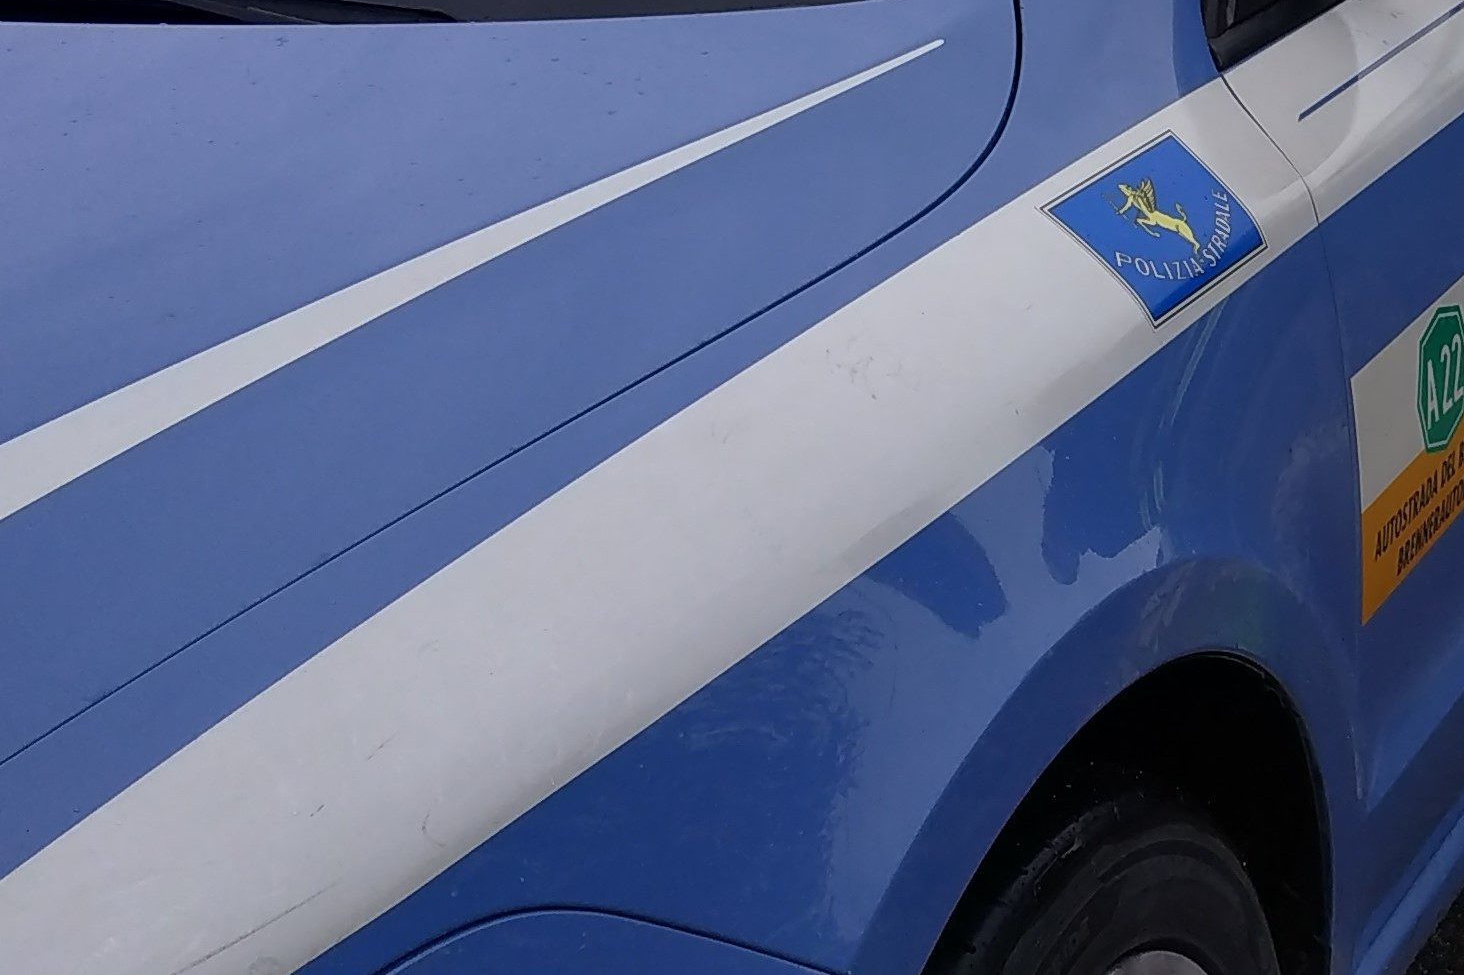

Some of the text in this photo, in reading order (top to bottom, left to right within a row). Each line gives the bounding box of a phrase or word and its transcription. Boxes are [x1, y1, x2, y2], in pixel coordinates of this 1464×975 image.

[1115, 189, 1231, 279] POLIZIA STRADALE
[1375, 469, 1438, 561] AUTOSTRADA
[1441, 450, 1455, 488] DEL
